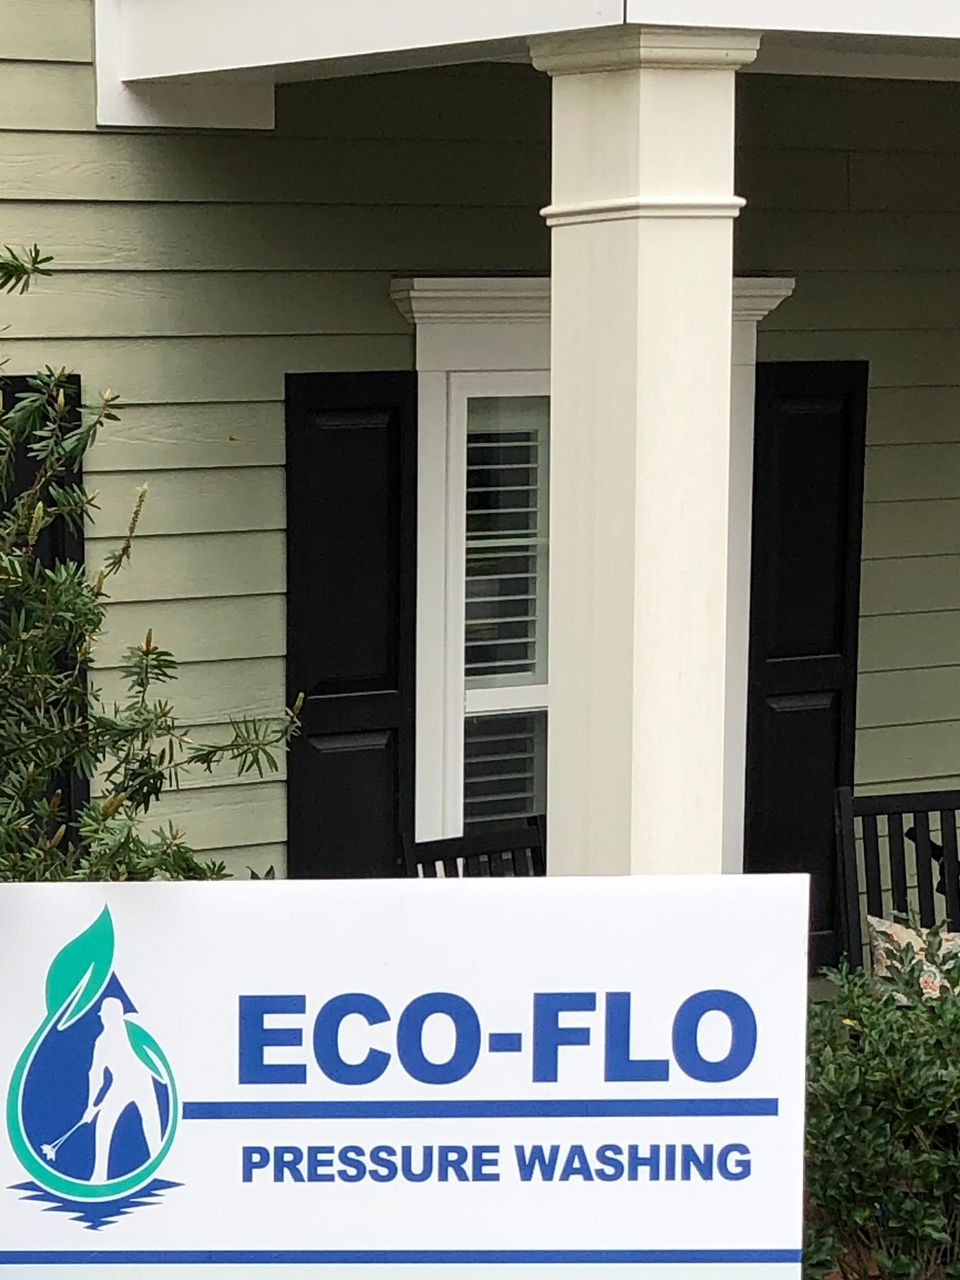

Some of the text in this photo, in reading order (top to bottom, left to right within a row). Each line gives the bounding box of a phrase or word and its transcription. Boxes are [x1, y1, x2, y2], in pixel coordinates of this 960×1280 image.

[239, 990, 758, 1086] ECO-FLO
[243, 1142, 752, 1183] PRESSURE WASHING
